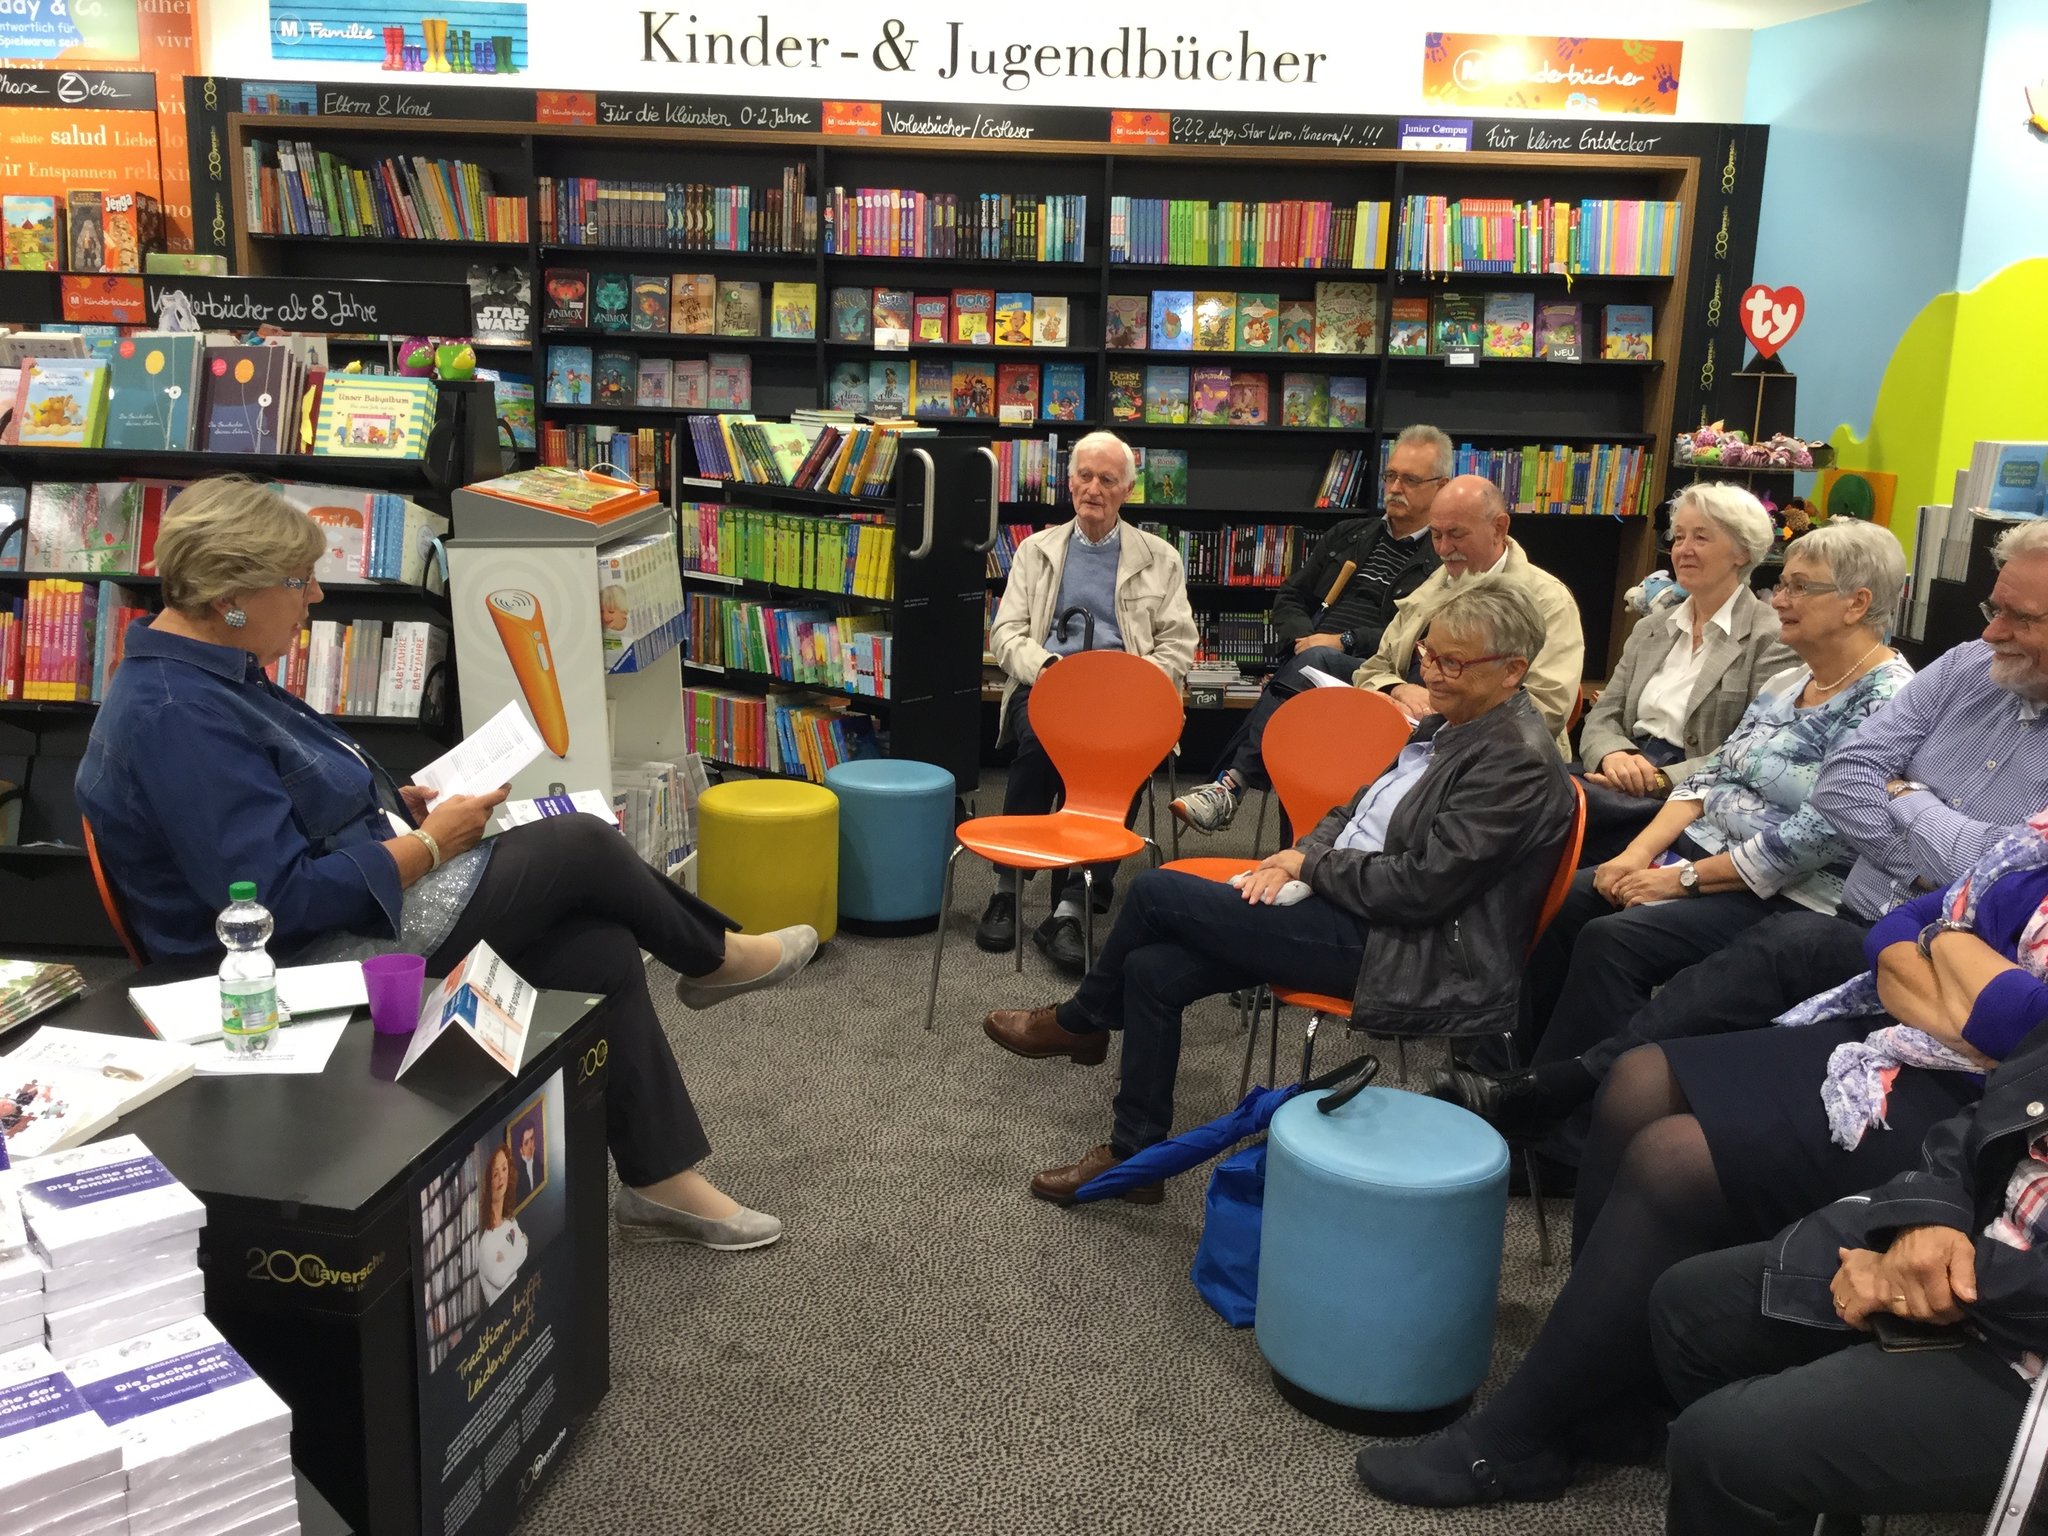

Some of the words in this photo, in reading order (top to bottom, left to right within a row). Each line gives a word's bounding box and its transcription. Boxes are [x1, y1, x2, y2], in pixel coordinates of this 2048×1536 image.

[58, 22, 76, 34] für
[308, 22, 376, 40] Familie
[872, 18, 919, 73] &
[938, 20, 1327, 91] Jugendbücher
[377, 95, 392, 116] &
[396, 94, 433, 117] Kind
[600, 102, 632, 122] Für
[636, 102, 660, 122] die
[665, 102, 731, 127] Kleinsten
[769, 107, 812, 128] Jahre
[51, 123, 107, 147] salud
[115, 130, 157, 147] Liebe
[1238, 122, 1266, 138] Star
[1402, 123, 1431, 135] Junior
[1485, 123, 1518, 149] Für
[1579, 127, 1662, 152] Entdecker
[29, 161, 117, 182] Entspannen
[105, 192, 133, 213] Jenga
[83, 295, 141, 308] Kinderbücher
[278, 293, 307, 321] ab
[312, 294, 328, 319] 8
[328, 290, 378, 326] Jahre
[917, 303, 945, 314] DORK
[956, 294, 991, 309] DORK
[476, 306, 529, 320] STAR
[548, 308, 583, 320] ANIMOX
[593, 312, 628, 325] ANIMOX
[1746, 289, 1797, 345] ty
[476, 318, 529, 332] WARS
[1554, 348, 1575, 358] NEU
[1109, 370, 1140, 381] Beast
[1112, 379, 1141, 388] Quest
[338, 393, 362, 401] Unser
[395, 636, 408, 690] BABYJAHRE
[411, 637, 425, 691] BABYJAHRE
[578, 1039, 608, 1087] 200
[46, 1182, 71, 1193] Die
[75, 1169, 122, 1186] Asche
[125, 1163, 150, 1177] der
[68, 1167, 154, 1193] Demokratie
[247, 1246, 327, 1288] 200
[456, 1317, 512, 1381] Tradition
[467, 1306, 536, 1403] Leidenschaft
[114, 1379, 143, 1393] Die
[146, 1364, 195, 1383] Asche
[197, 1353, 223, 1368] der
[138, 1359, 230, 1394] Demokratie
[207, 1370, 238, 1386] 2016/17
[28, 1384, 56, 1400] der
[37, 1403, 71, 1418] 2016/17
